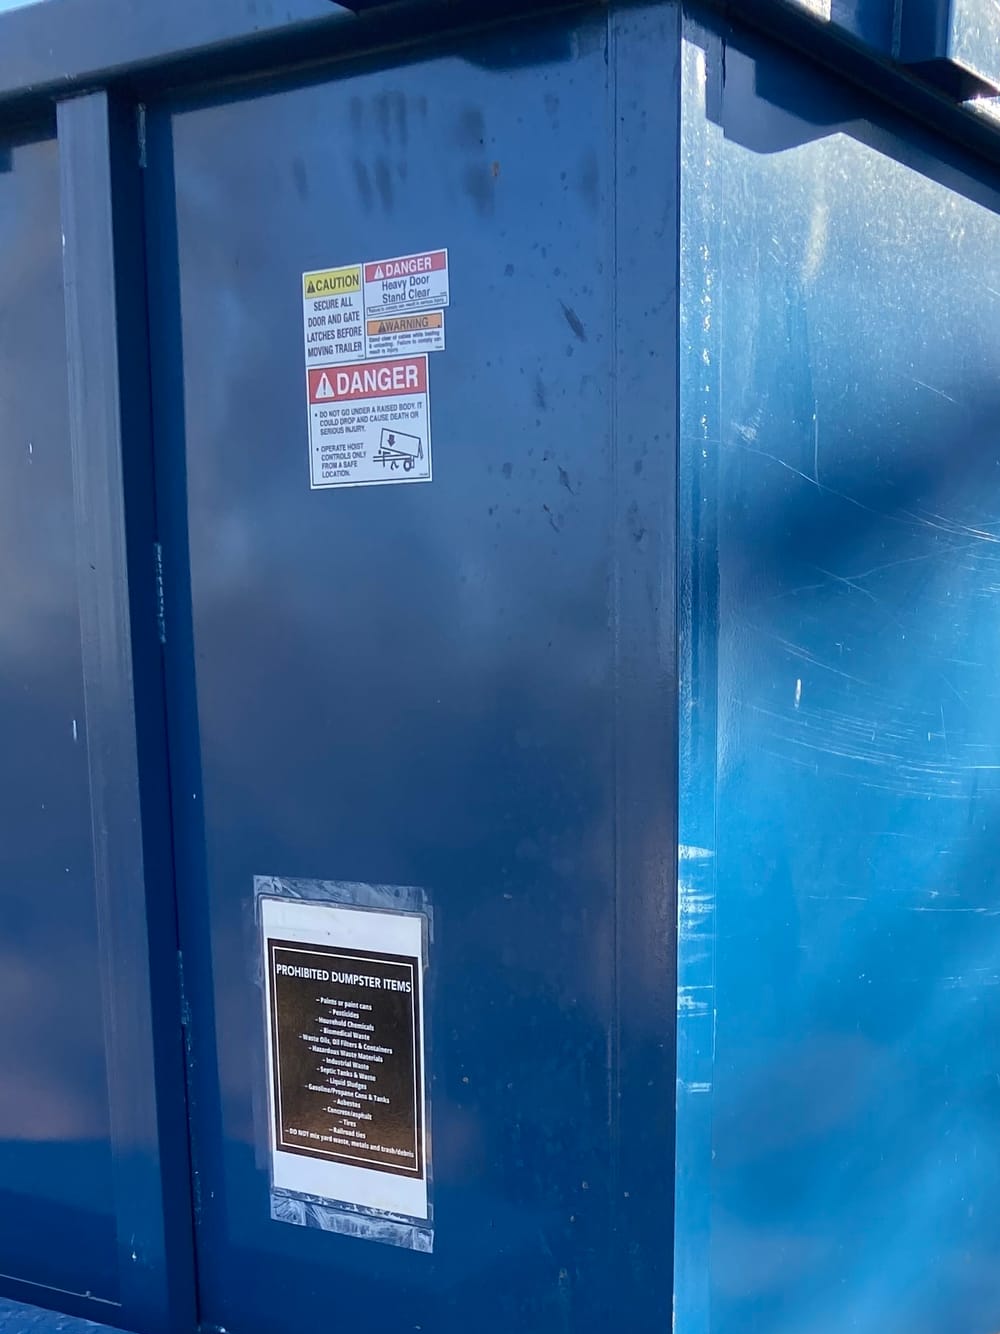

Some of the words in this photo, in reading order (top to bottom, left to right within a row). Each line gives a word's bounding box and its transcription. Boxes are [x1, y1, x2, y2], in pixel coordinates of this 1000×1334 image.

[386, 258, 432, 277] DANGER
[316, 275, 359, 292] CAUTION
[382, 279, 407, 291] Heavy
[410, 276, 430, 286] Door
[383, 291, 405, 303] Stand
[409, 288, 430, 299] Clear
[314, 298, 339, 311] SECURE
[341, 297, 352, 307] ALL
[308, 315, 326, 327] DOOR
[328, 314, 341, 325] AND
[343, 311, 360, 323] GATE
[386, 317, 428, 333] WARNING
[307, 330, 335, 343] LATCHES
[337, 327, 362, 338] BEFORE
[308, 345, 333, 357] MOVING
[335, 342, 362, 354] TRAILER
[337, 365, 418, 395] DANGER
[351, 407, 370, 415] UNDER
[377, 404, 397, 413] RAISED
[320, 419, 338, 427] COULD
[340, 417, 356, 425] DROP
[370, 414, 388, 422] CAUSE
[390, 413, 409, 421] DEATH
[410, 411, 418, 419] OR
[321, 427, 344, 435] SERIOUS
[321, 444, 346, 452] OPERATE
[322, 453, 351, 461] CONTROLS
[352, 451, 366, 459] ONLY
[343, 460, 357, 468] SAFE
[276, 964, 329, 981] PROHIBITED
[332, 973, 381, 988] DUMPSTER
[383, 979, 411, 993] ITEMS
[319, 1017, 346, 1028] Household
[347, 1021, 374, 1031] Chemicals
[324, 1028, 352, 1038] Biomedical
[353, 1032, 370, 1040] Waste
[303, 1034, 318, 1042] Waste
[364, 1044, 392, 1054] Containers
[320, 1066, 336, 1076] Septic
[353, 1061, 369, 1070] Waste
[343, 1119, 356, 1127] Tires
